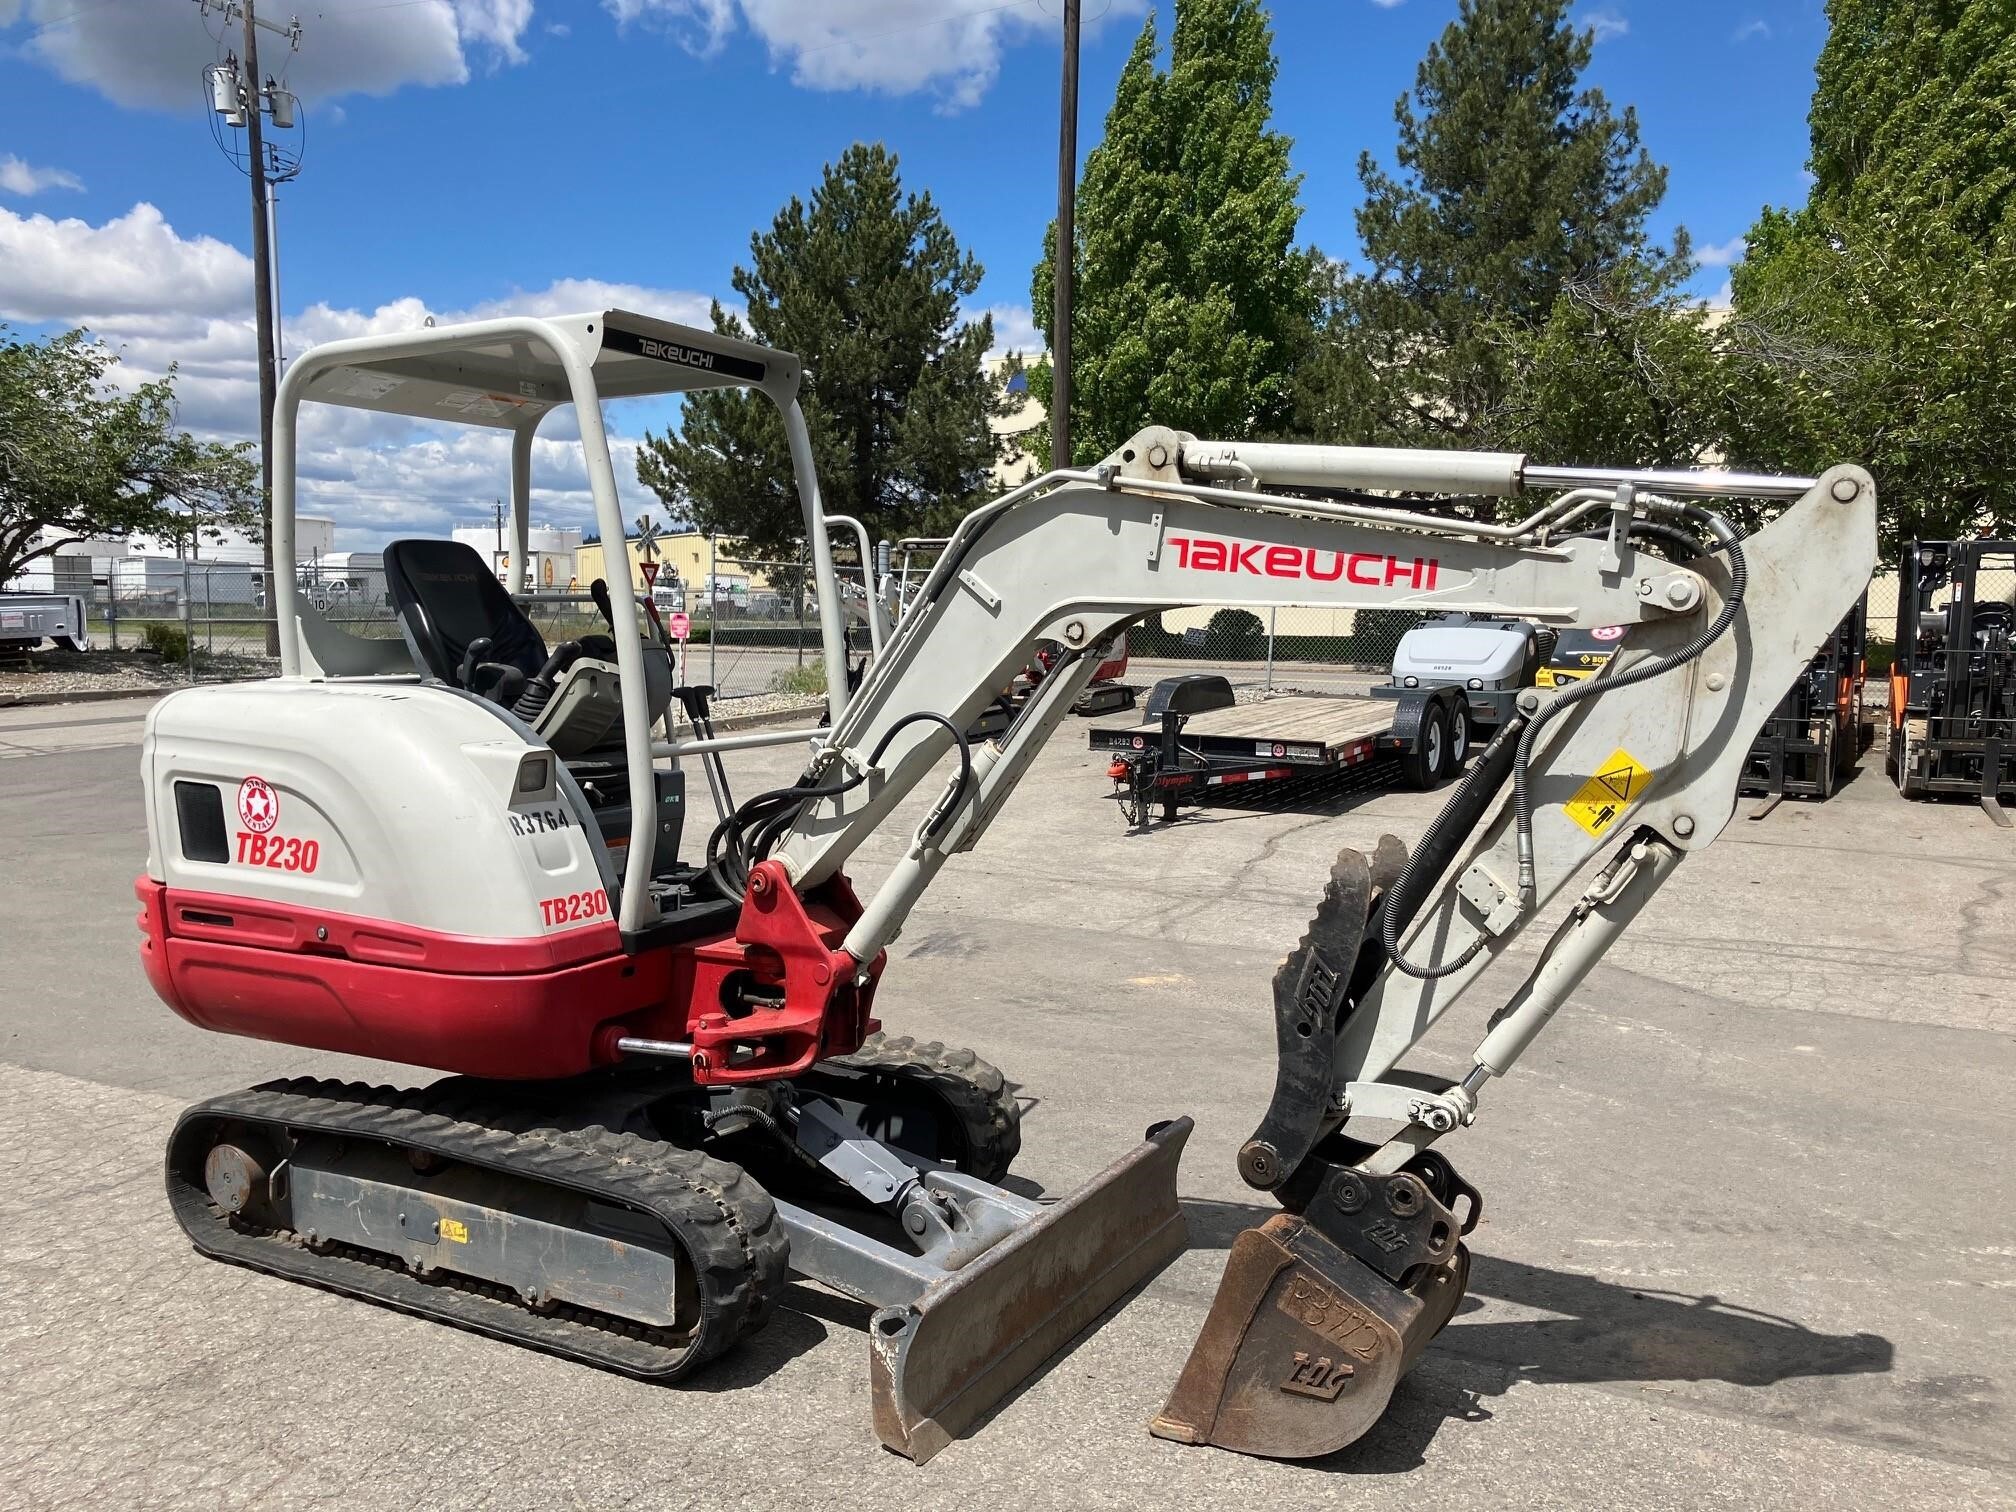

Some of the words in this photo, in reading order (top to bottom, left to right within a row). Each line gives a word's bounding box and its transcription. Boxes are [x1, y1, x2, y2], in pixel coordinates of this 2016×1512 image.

[314, 599, 325, 610] 10
[508, 808, 570, 836] R3764
[237, 831, 320, 874] TB230
[539, 888, 608, 927] TB230
